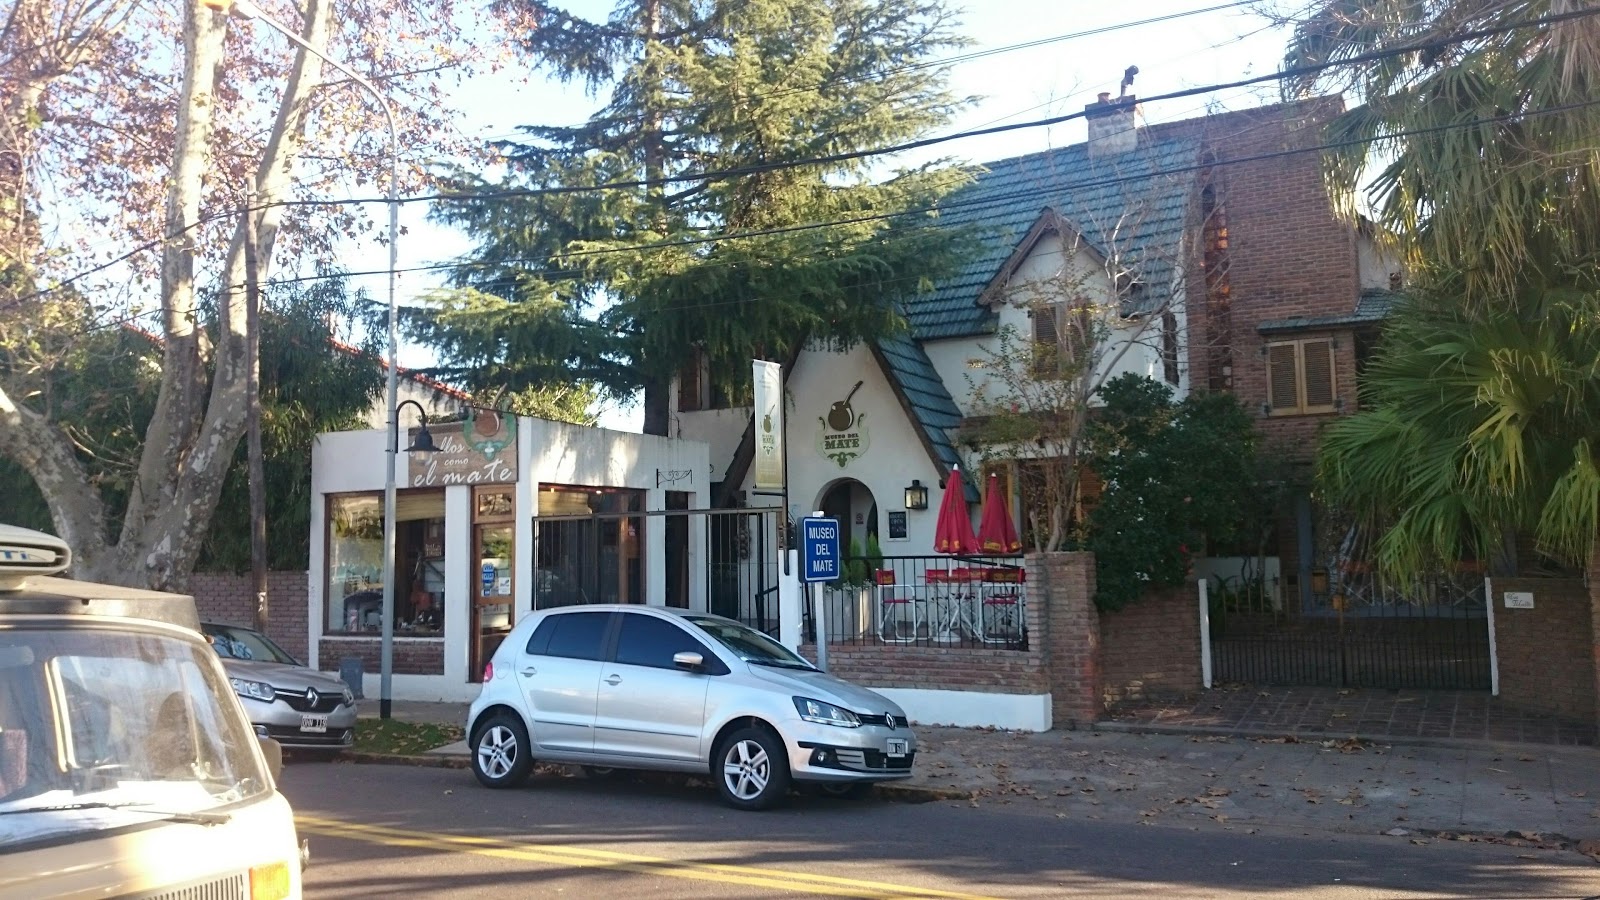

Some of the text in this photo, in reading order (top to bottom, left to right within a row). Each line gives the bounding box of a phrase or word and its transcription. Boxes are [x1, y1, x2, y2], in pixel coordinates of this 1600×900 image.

[825, 439, 859, 450] MATE
[444, 458, 469, 466] como
[414, 459, 512, 486] el mate
[808, 527, 835, 539] MUSEO
[815, 543, 831, 555] DEL
[813, 559, 833, 572] MATE
